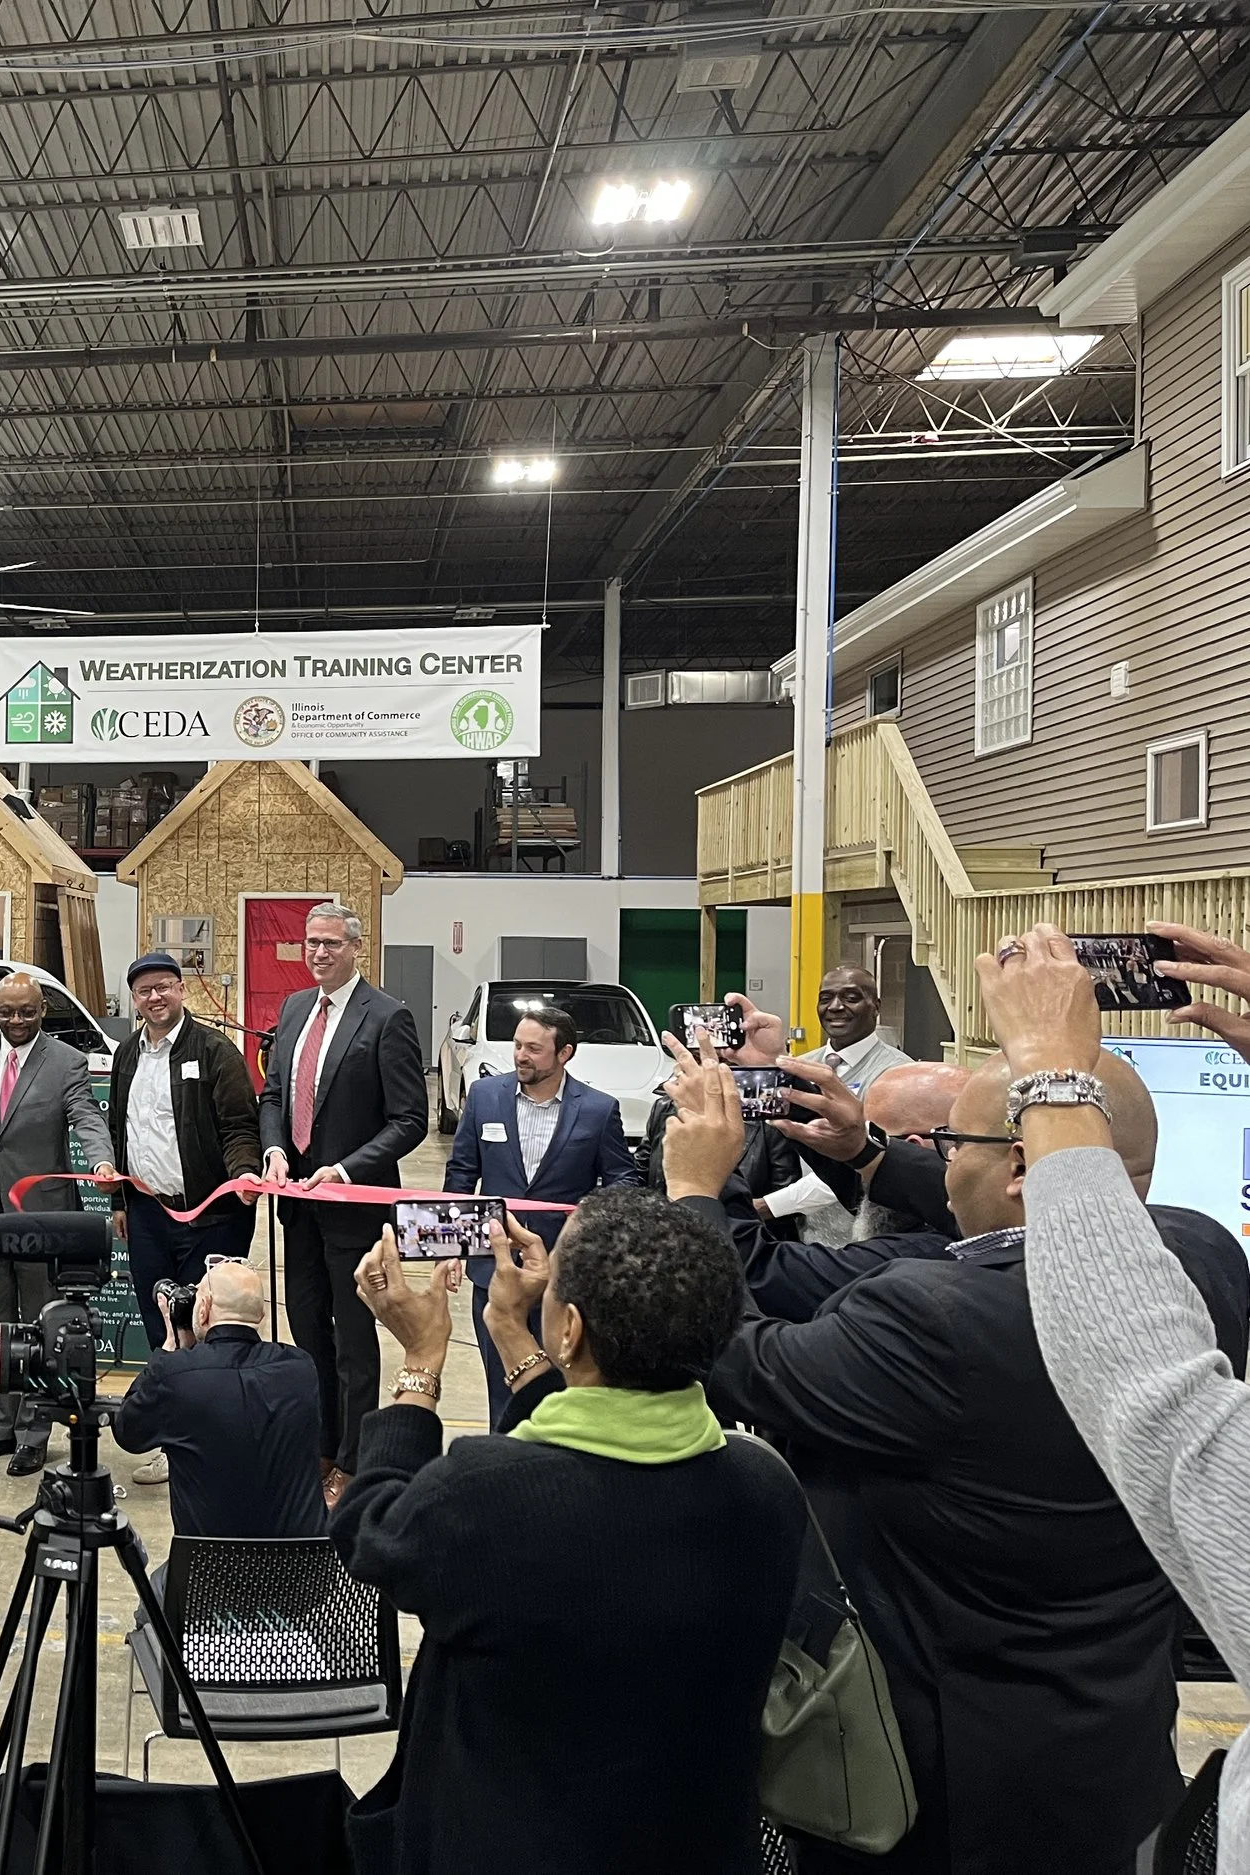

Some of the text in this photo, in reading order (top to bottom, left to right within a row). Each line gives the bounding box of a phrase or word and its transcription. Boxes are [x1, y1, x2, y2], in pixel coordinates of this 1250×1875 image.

[79, 652, 523, 681] WEATHERIZATION TRAINING CENTER
[291, 703, 325, 712] Illinois
[291, 711, 421, 723] Department of Commerce
[118, 710, 211, 738] CEDA
[462, 731, 502, 750] IHWAP
[1200, 1072, 1250, 1091] EQUI
